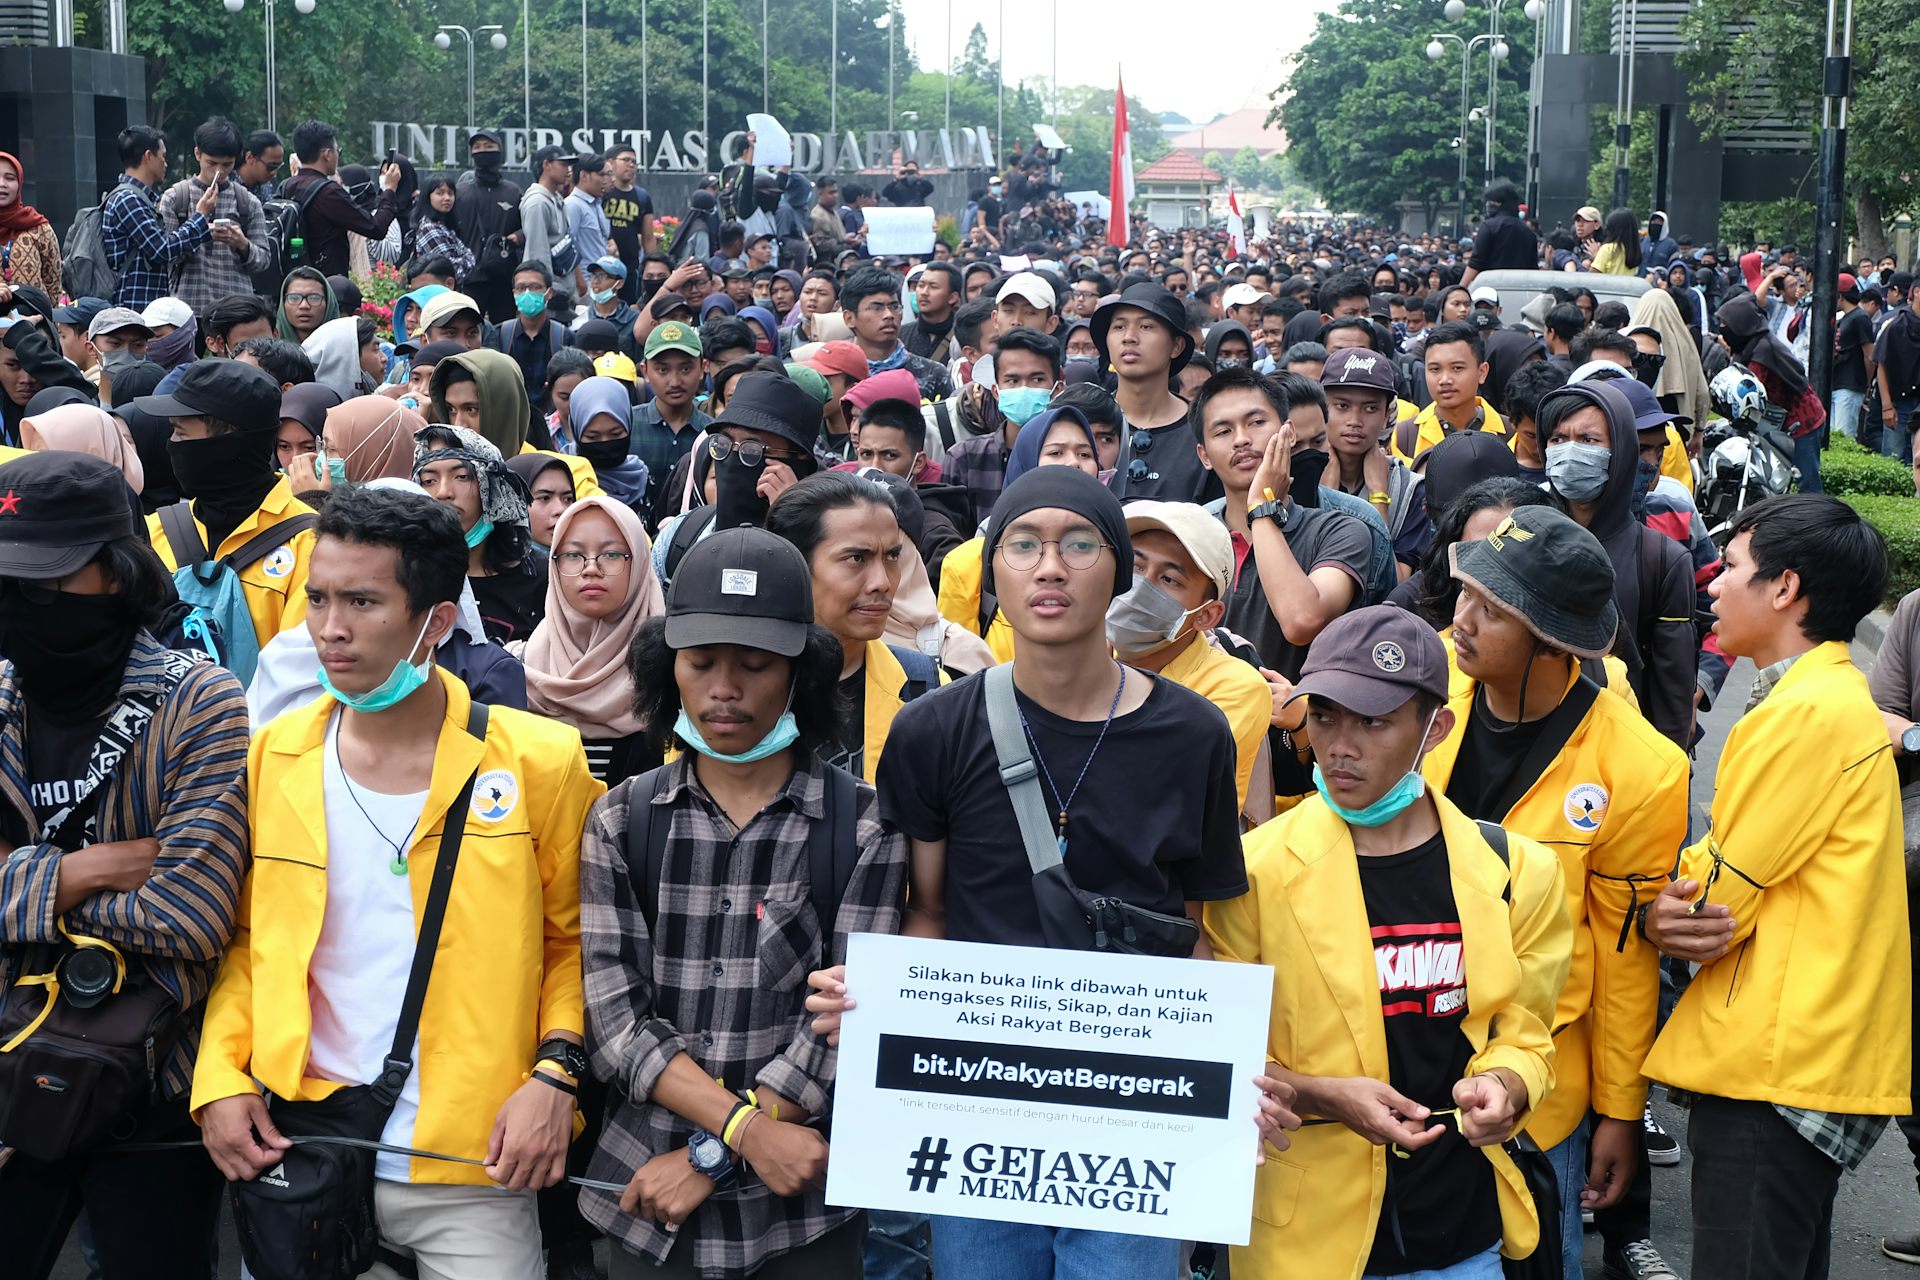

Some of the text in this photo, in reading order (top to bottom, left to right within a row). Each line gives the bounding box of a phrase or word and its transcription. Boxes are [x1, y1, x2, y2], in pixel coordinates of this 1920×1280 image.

[720, 130, 896, 174] GDJAH
[603, 198, 640, 221] GAP
[612, 219, 627, 228] USA
[908, 965, 1208, 1002] Silakan buka link dibawah untuk
[900, 988, 1213, 1024] mengakses Rilis, Sikap, dan Kajian
[956, 1011, 1152, 1039] Aksi Rakyat Bergerak
[912, 1053, 1195, 1097] bit.ly/RakyatBergerak
[927, 1101, 976, 1114] tersebut
[979, 1105, 1021, 1117] sensitif
[1023, 1109, 1068, 1122] dengan
[1071, 1111, 1105, 1125] huruf
[1107, 1115, 1138, 1128] besar
[1141, 1119, 1164, 1131] dan
[1167, 1122, 1194, 1133] kecil
[962, 1143, 1177, 1192] GEJAYAN
[959, 1175, 1168, 1216] MEMANGGIL
